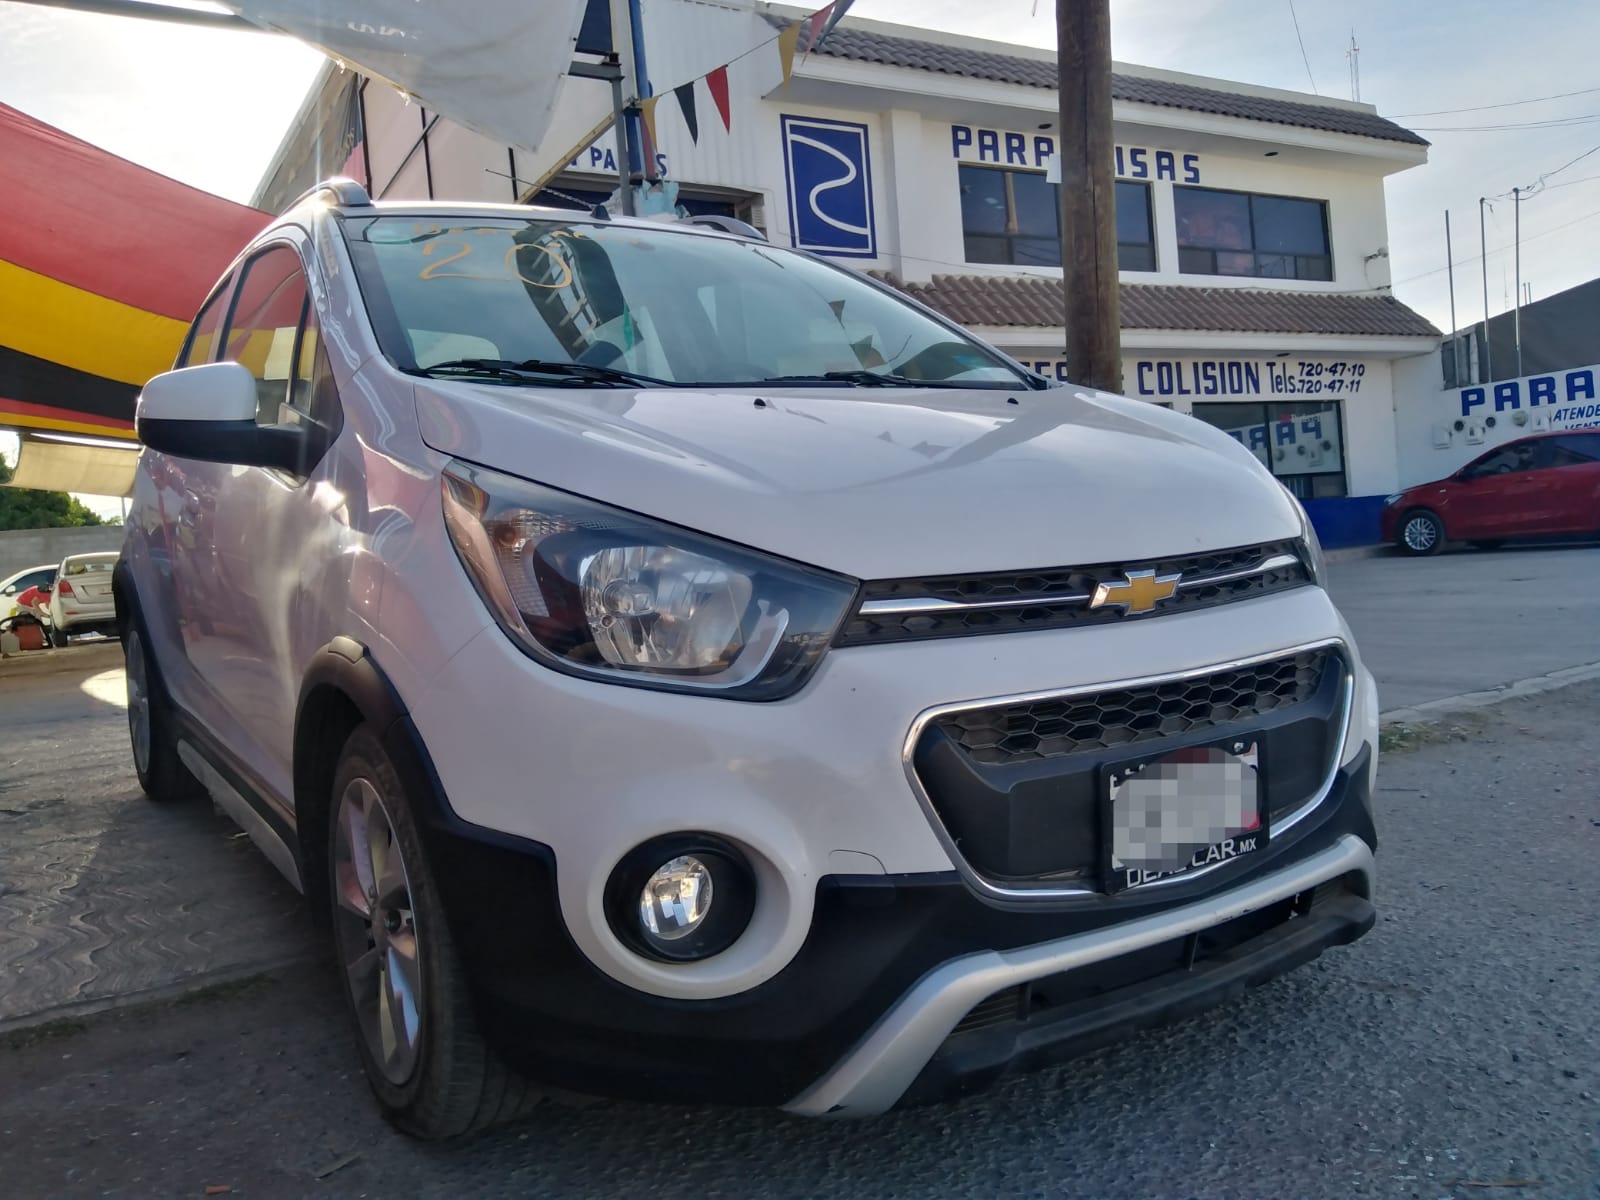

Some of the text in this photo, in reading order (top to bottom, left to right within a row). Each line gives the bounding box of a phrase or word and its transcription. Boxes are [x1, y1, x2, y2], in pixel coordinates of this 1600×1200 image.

[951, 125, 1200, 183] PARAISAS
[1137, 361, 1260, 395] COLISION
[1460, 370, 1595, 417] PARA
